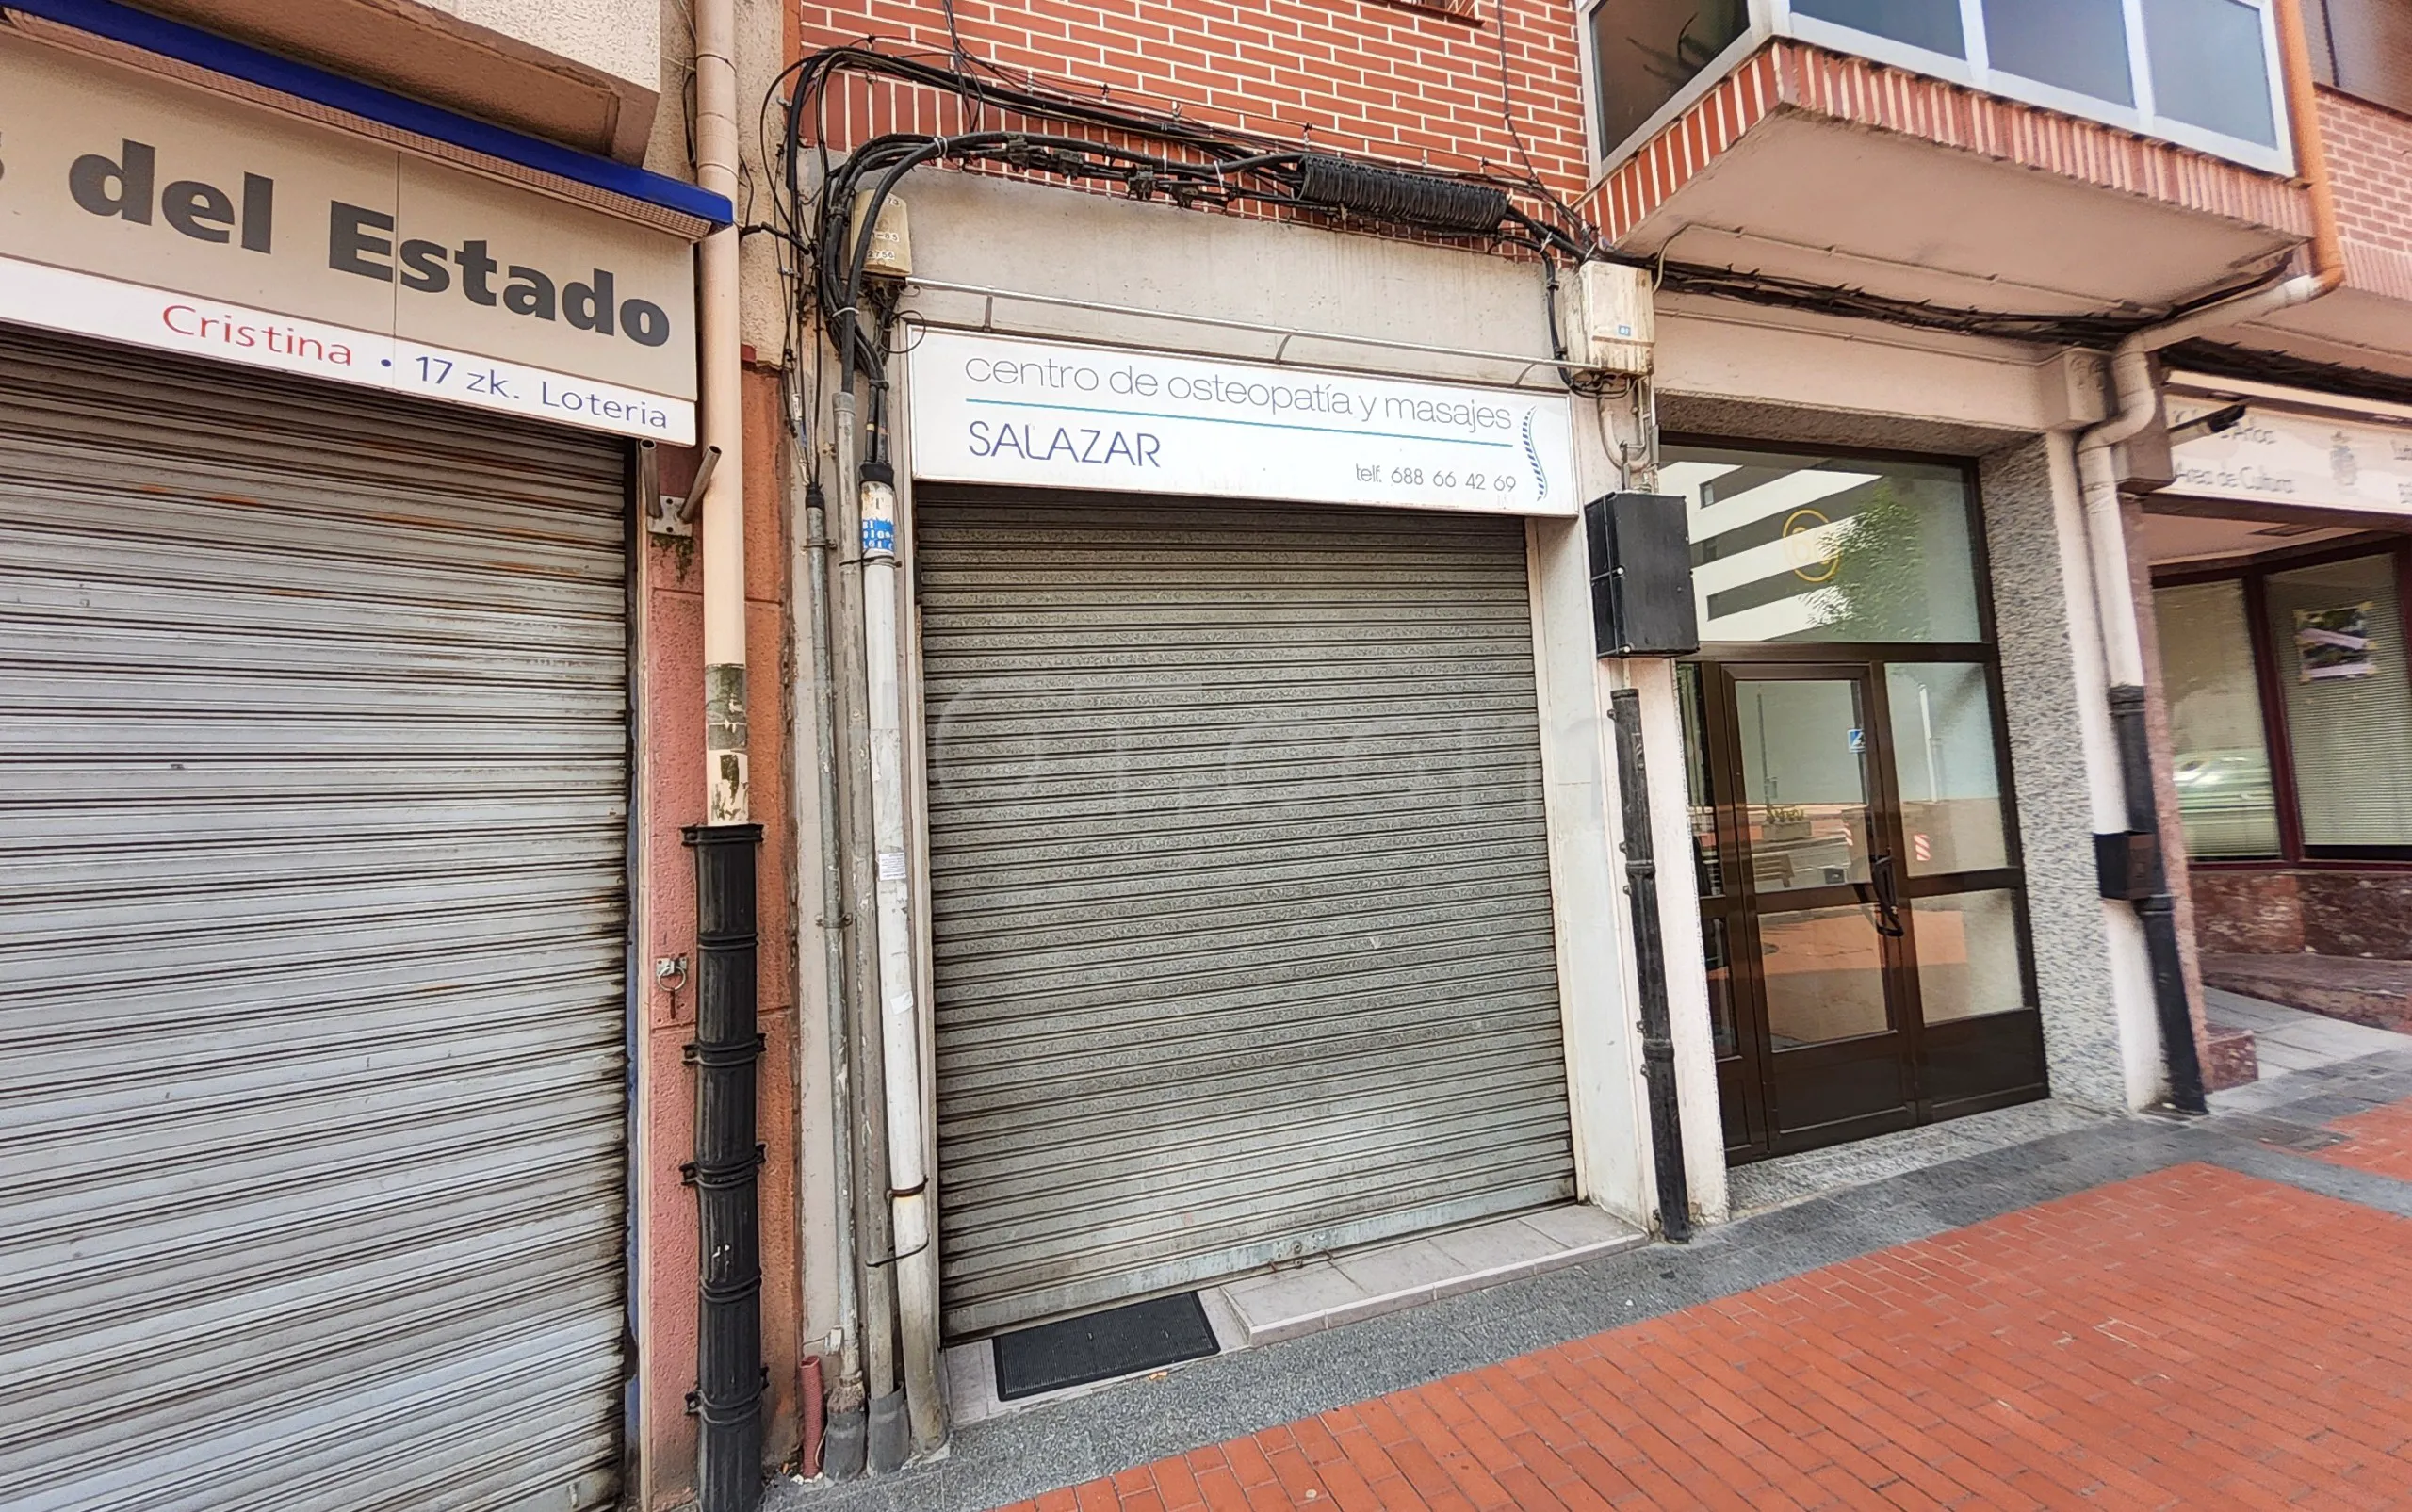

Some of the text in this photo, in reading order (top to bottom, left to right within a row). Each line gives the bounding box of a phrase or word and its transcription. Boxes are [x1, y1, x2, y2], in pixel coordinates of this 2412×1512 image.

[69, 138, 670, 348] del Estado
[163, 305, 667, 430] Cristina 17 zk. Loteria
[966, 356, 1512, 434] centro de osteopatía y masajes
[969, 420, 1161, 468] SALAZAR
[1356, 463, 1517, 493] telf. 688 66 42 69
